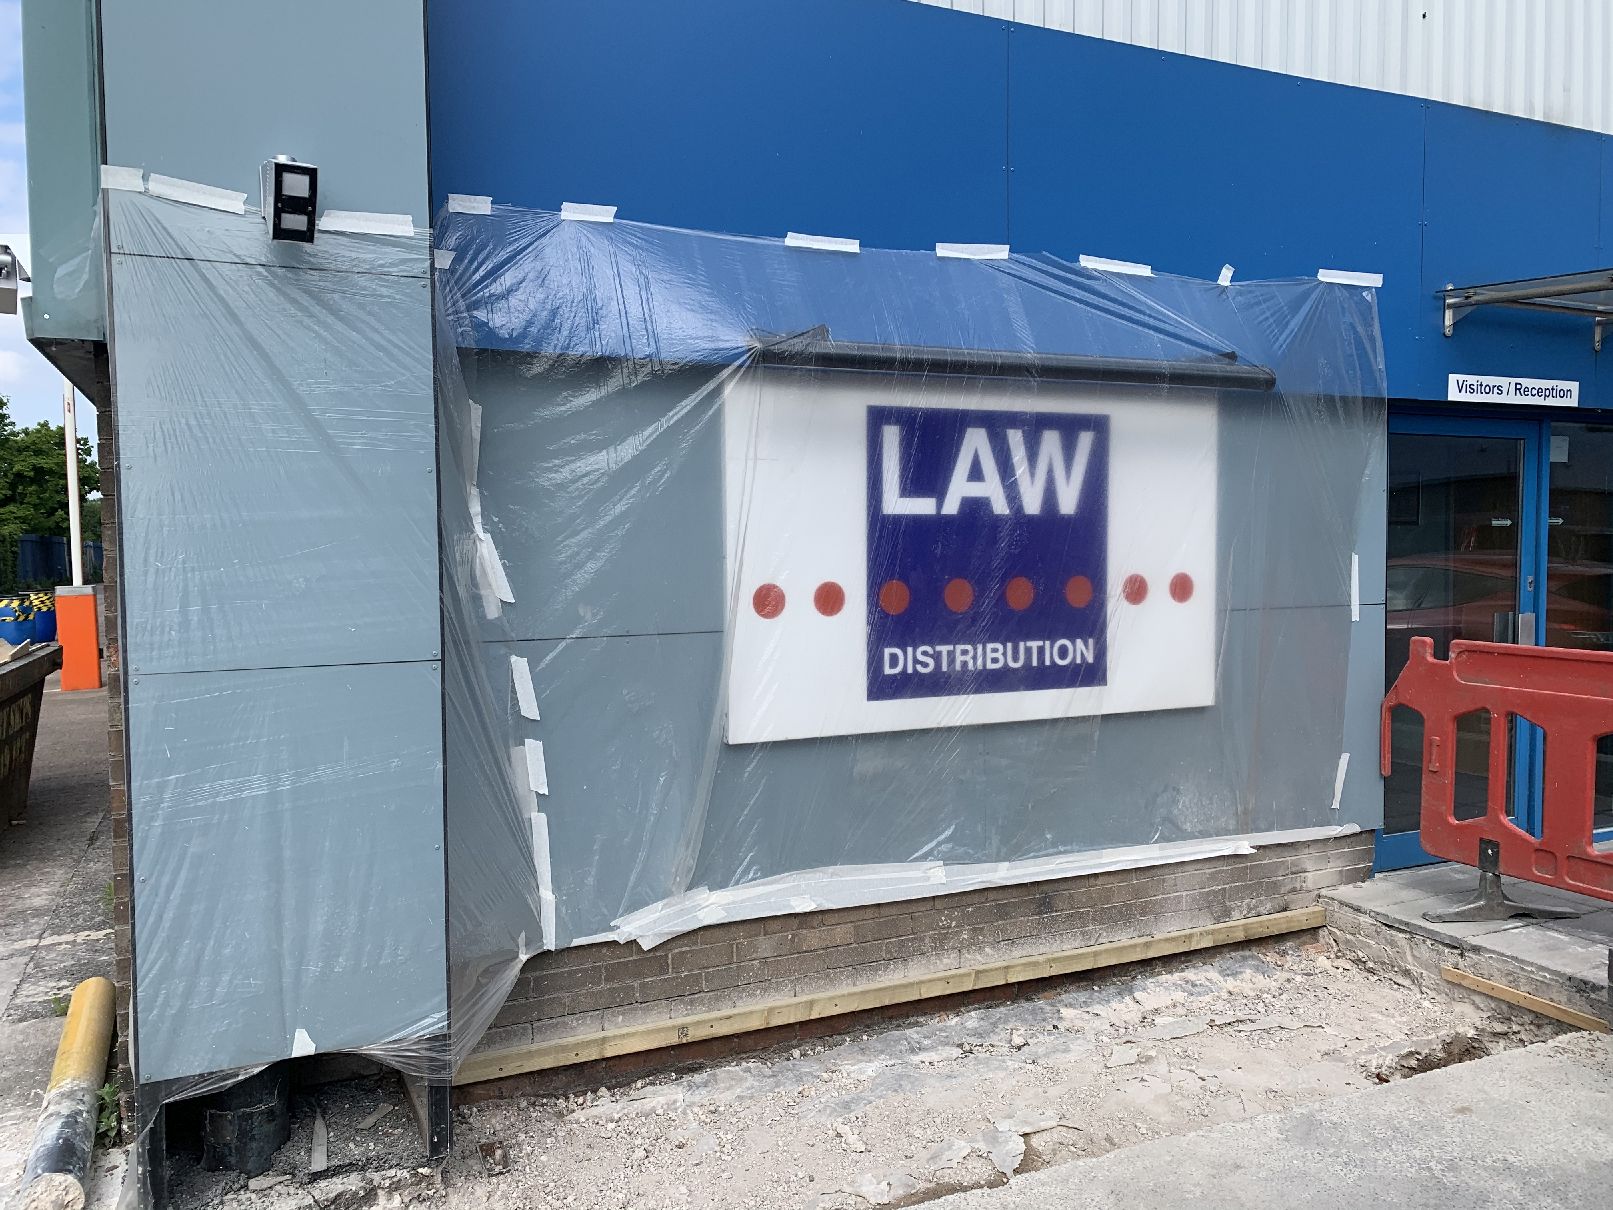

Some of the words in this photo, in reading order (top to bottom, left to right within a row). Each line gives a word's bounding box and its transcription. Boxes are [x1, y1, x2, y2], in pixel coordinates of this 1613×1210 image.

[1456, 379, 1503, 395] Visitors
[1506, 382, 1511, 396] /
[1514, 382, 1572, 401] Reception
[882, 425, 1095, 515] LAW
[883, 639, 1095, 675] DISTRIBUTION
